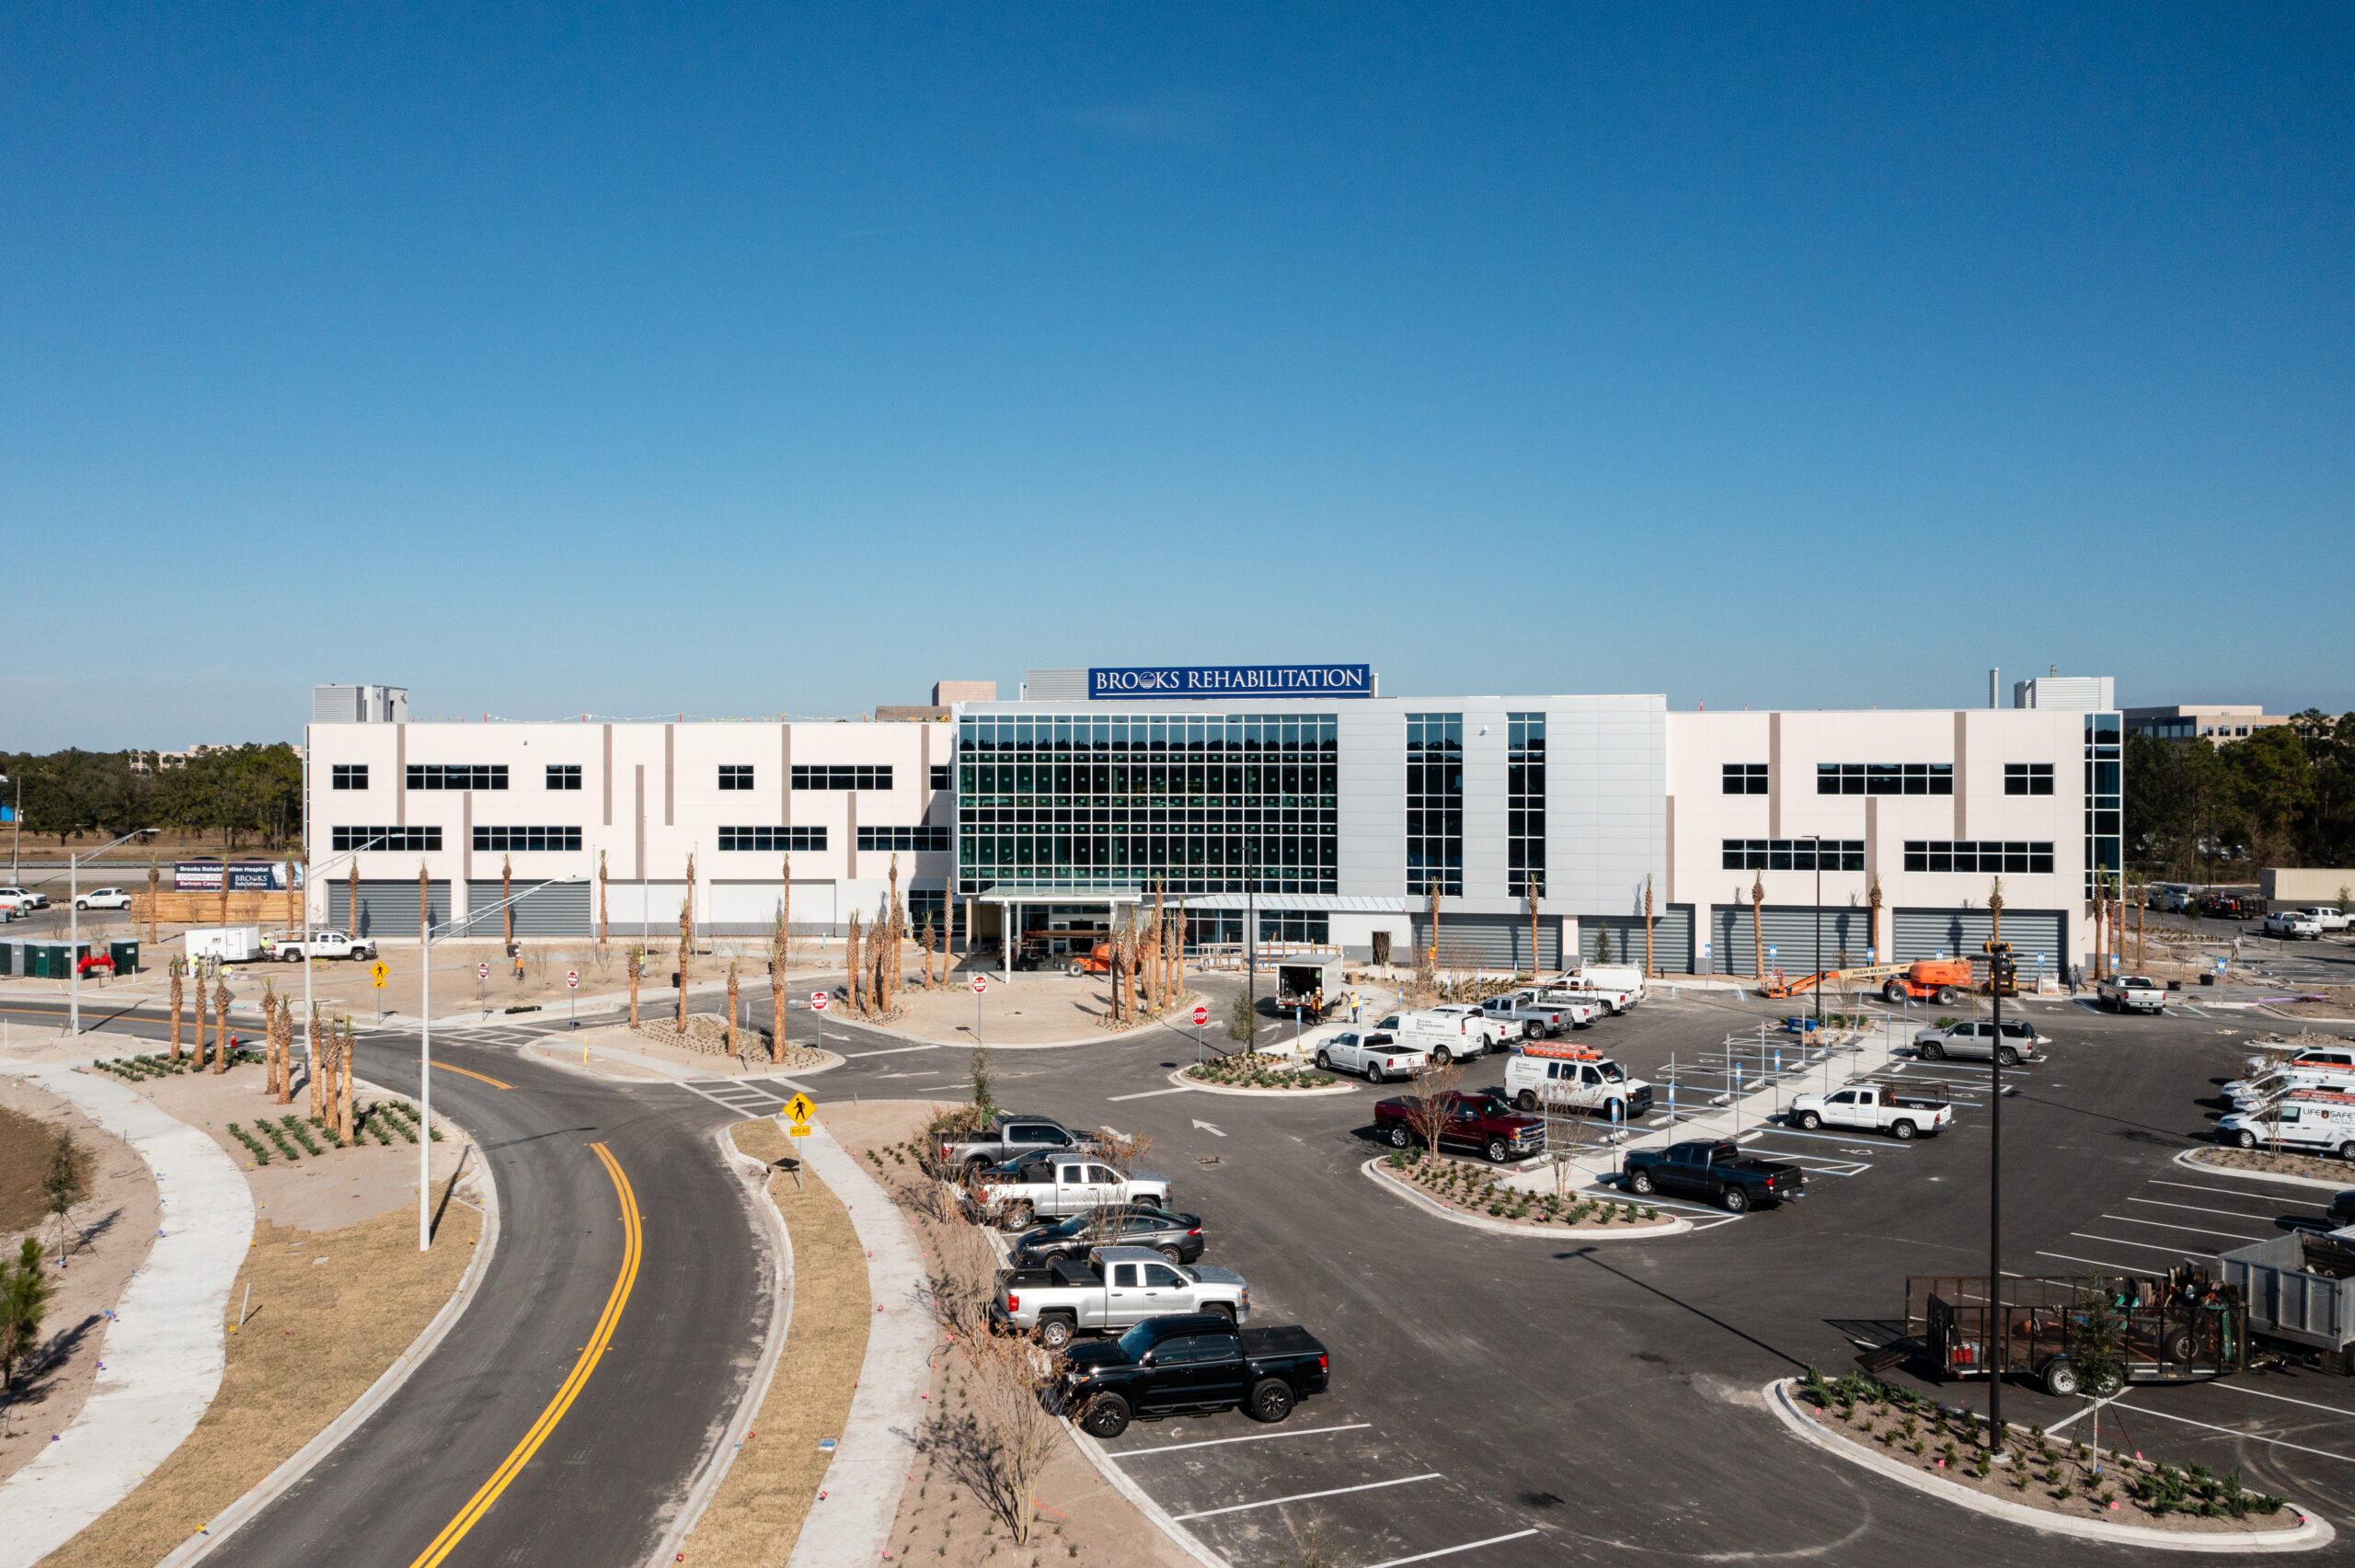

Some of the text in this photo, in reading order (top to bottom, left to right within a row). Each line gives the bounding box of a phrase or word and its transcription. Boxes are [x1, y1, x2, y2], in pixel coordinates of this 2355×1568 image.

[1097, 669, 1362, 689] BROOKS REHABILITATION
[1193, 1012, 1207, 1020] STOP
